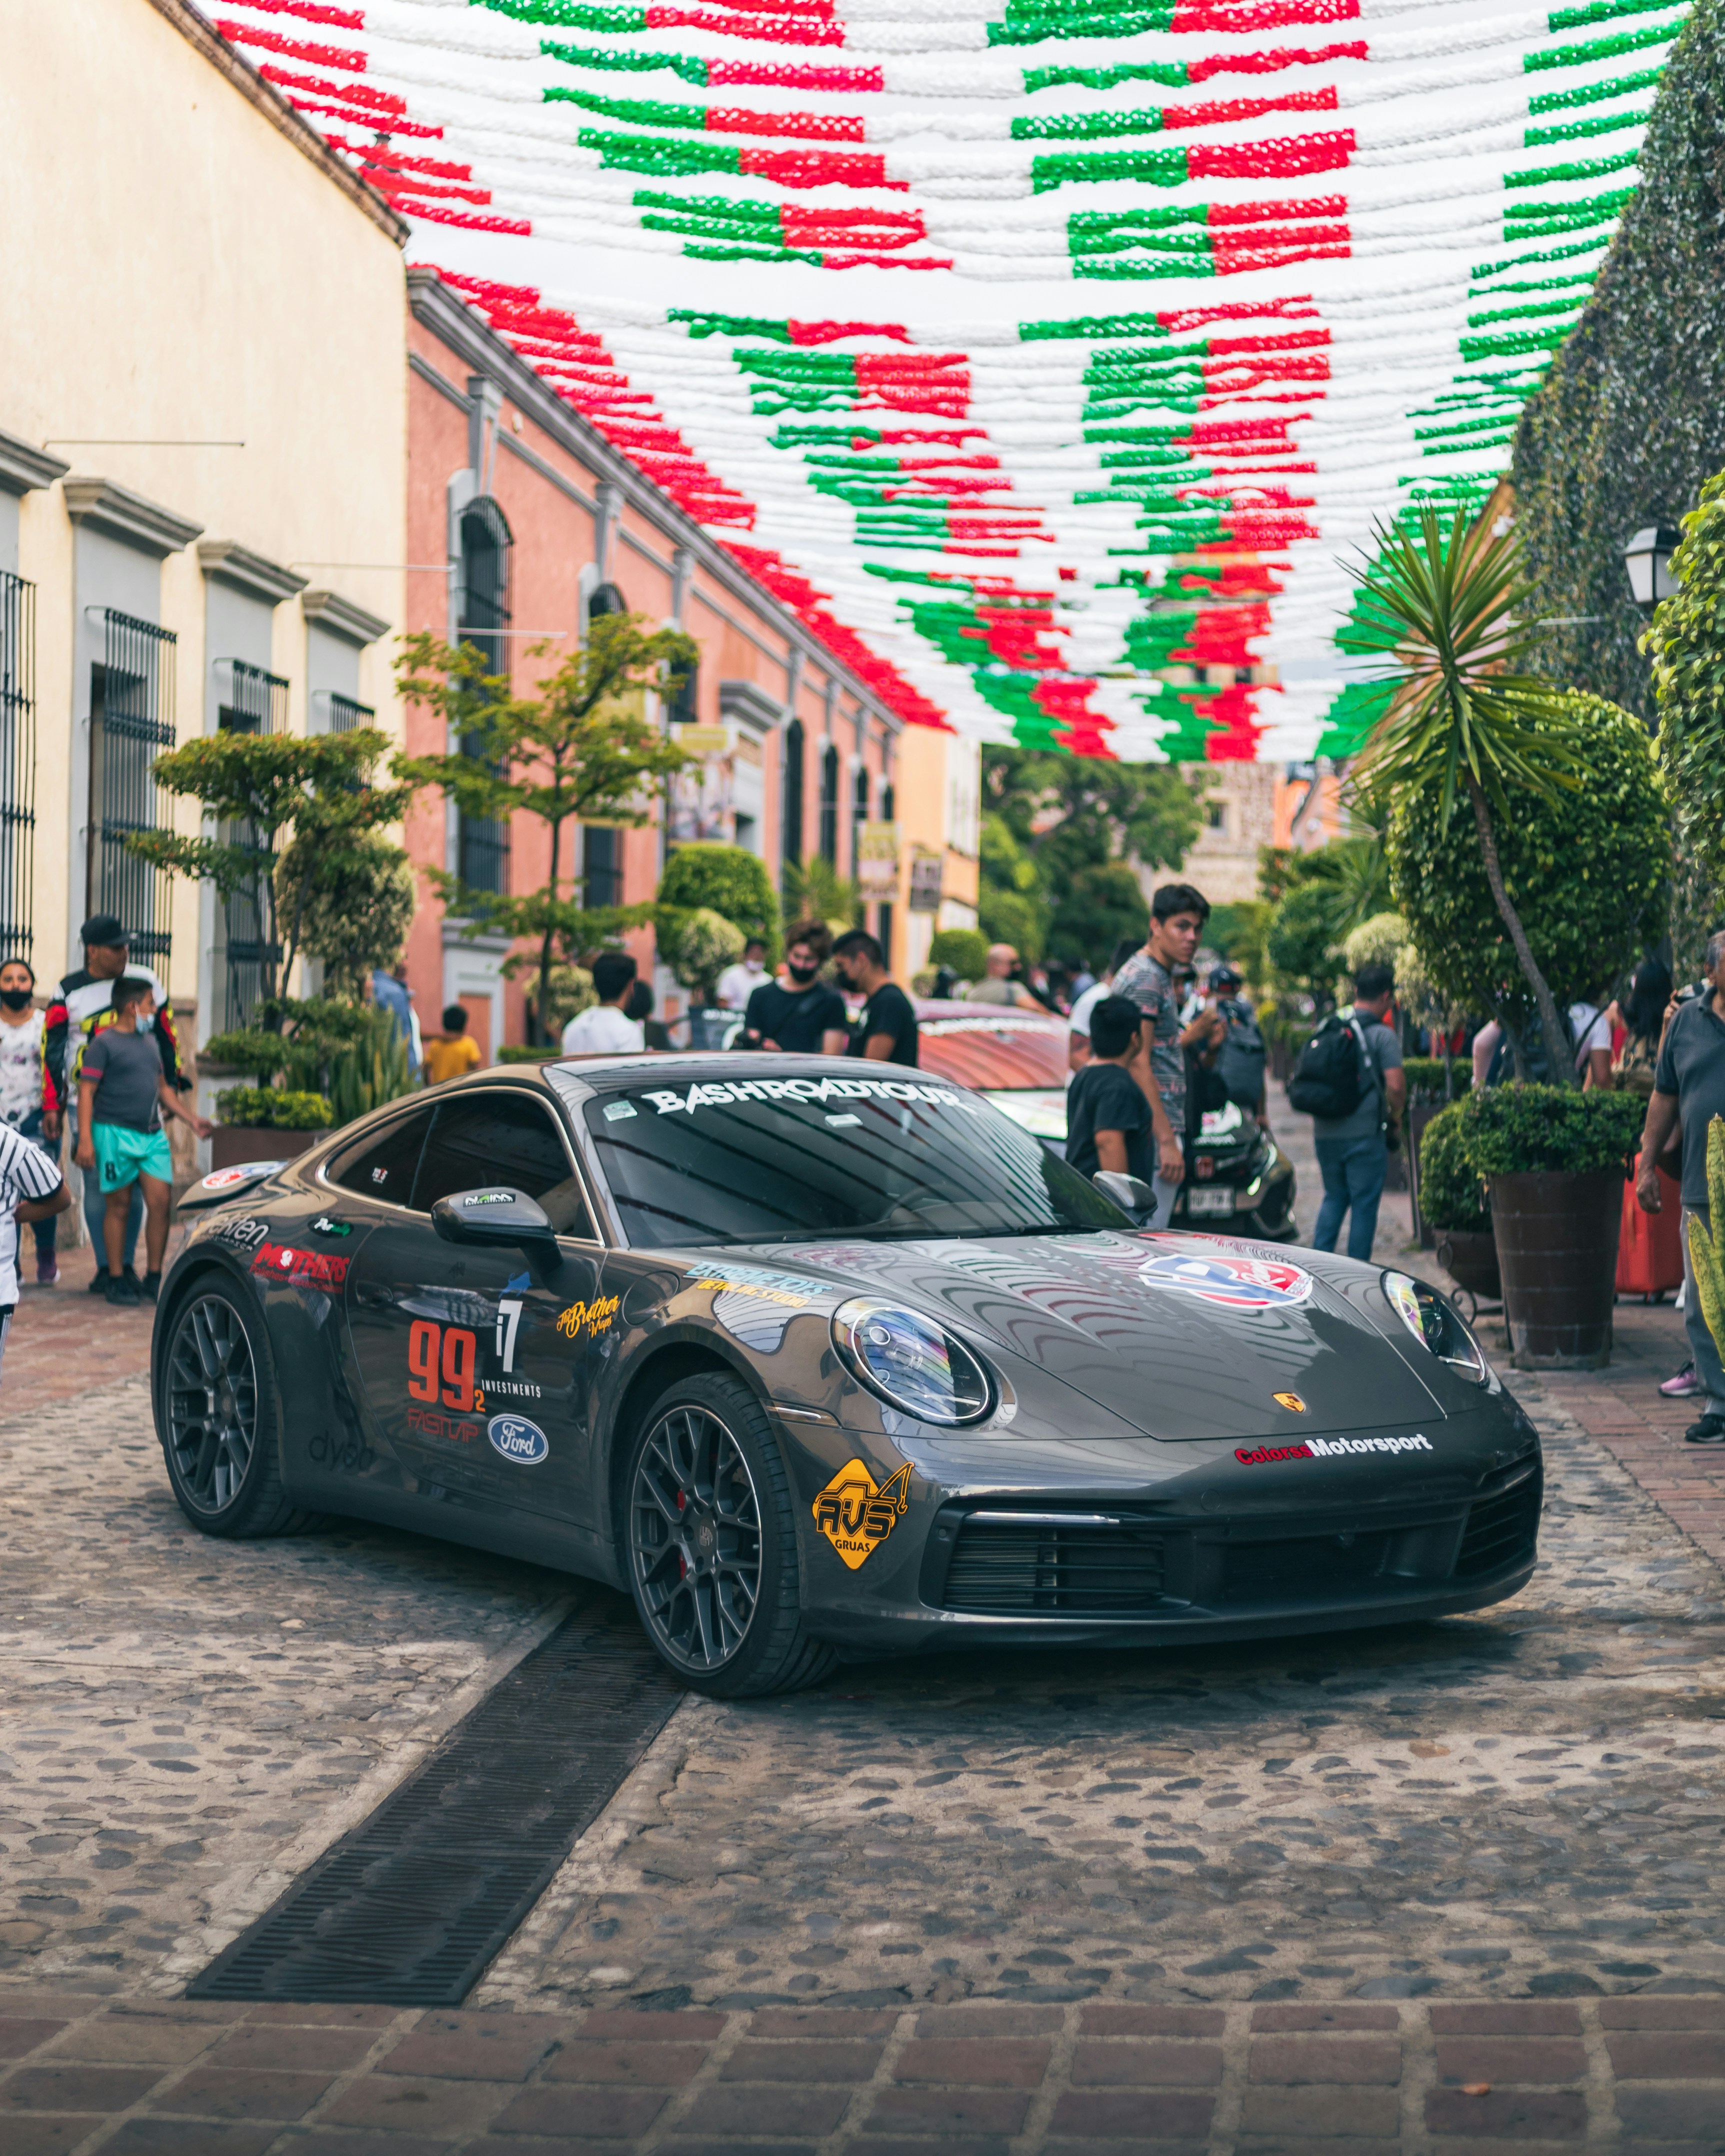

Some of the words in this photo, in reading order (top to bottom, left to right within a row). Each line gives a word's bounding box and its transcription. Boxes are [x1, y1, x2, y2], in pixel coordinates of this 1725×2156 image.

[642, 1077, 977, 1116] BASHROADTOUR
[254, 1242, 350, 1283] MOTHERS
[686, 1260, 774, 1286] EXTREME
[770, 1275, 834, 1296] TOYS
[696, 1280, 758, 1296] DETAILING
[757, 1288, 810, 1308] STUDIO
[556, 1308, 572, 1332] The
[588, 1316, 612, 1338] Wraps
[482, 1379, 541, 1398] INVESTMENTS
[500, 1422, 536, 1456] Ford
[834, 1539, 870, 1552] GRUAS
